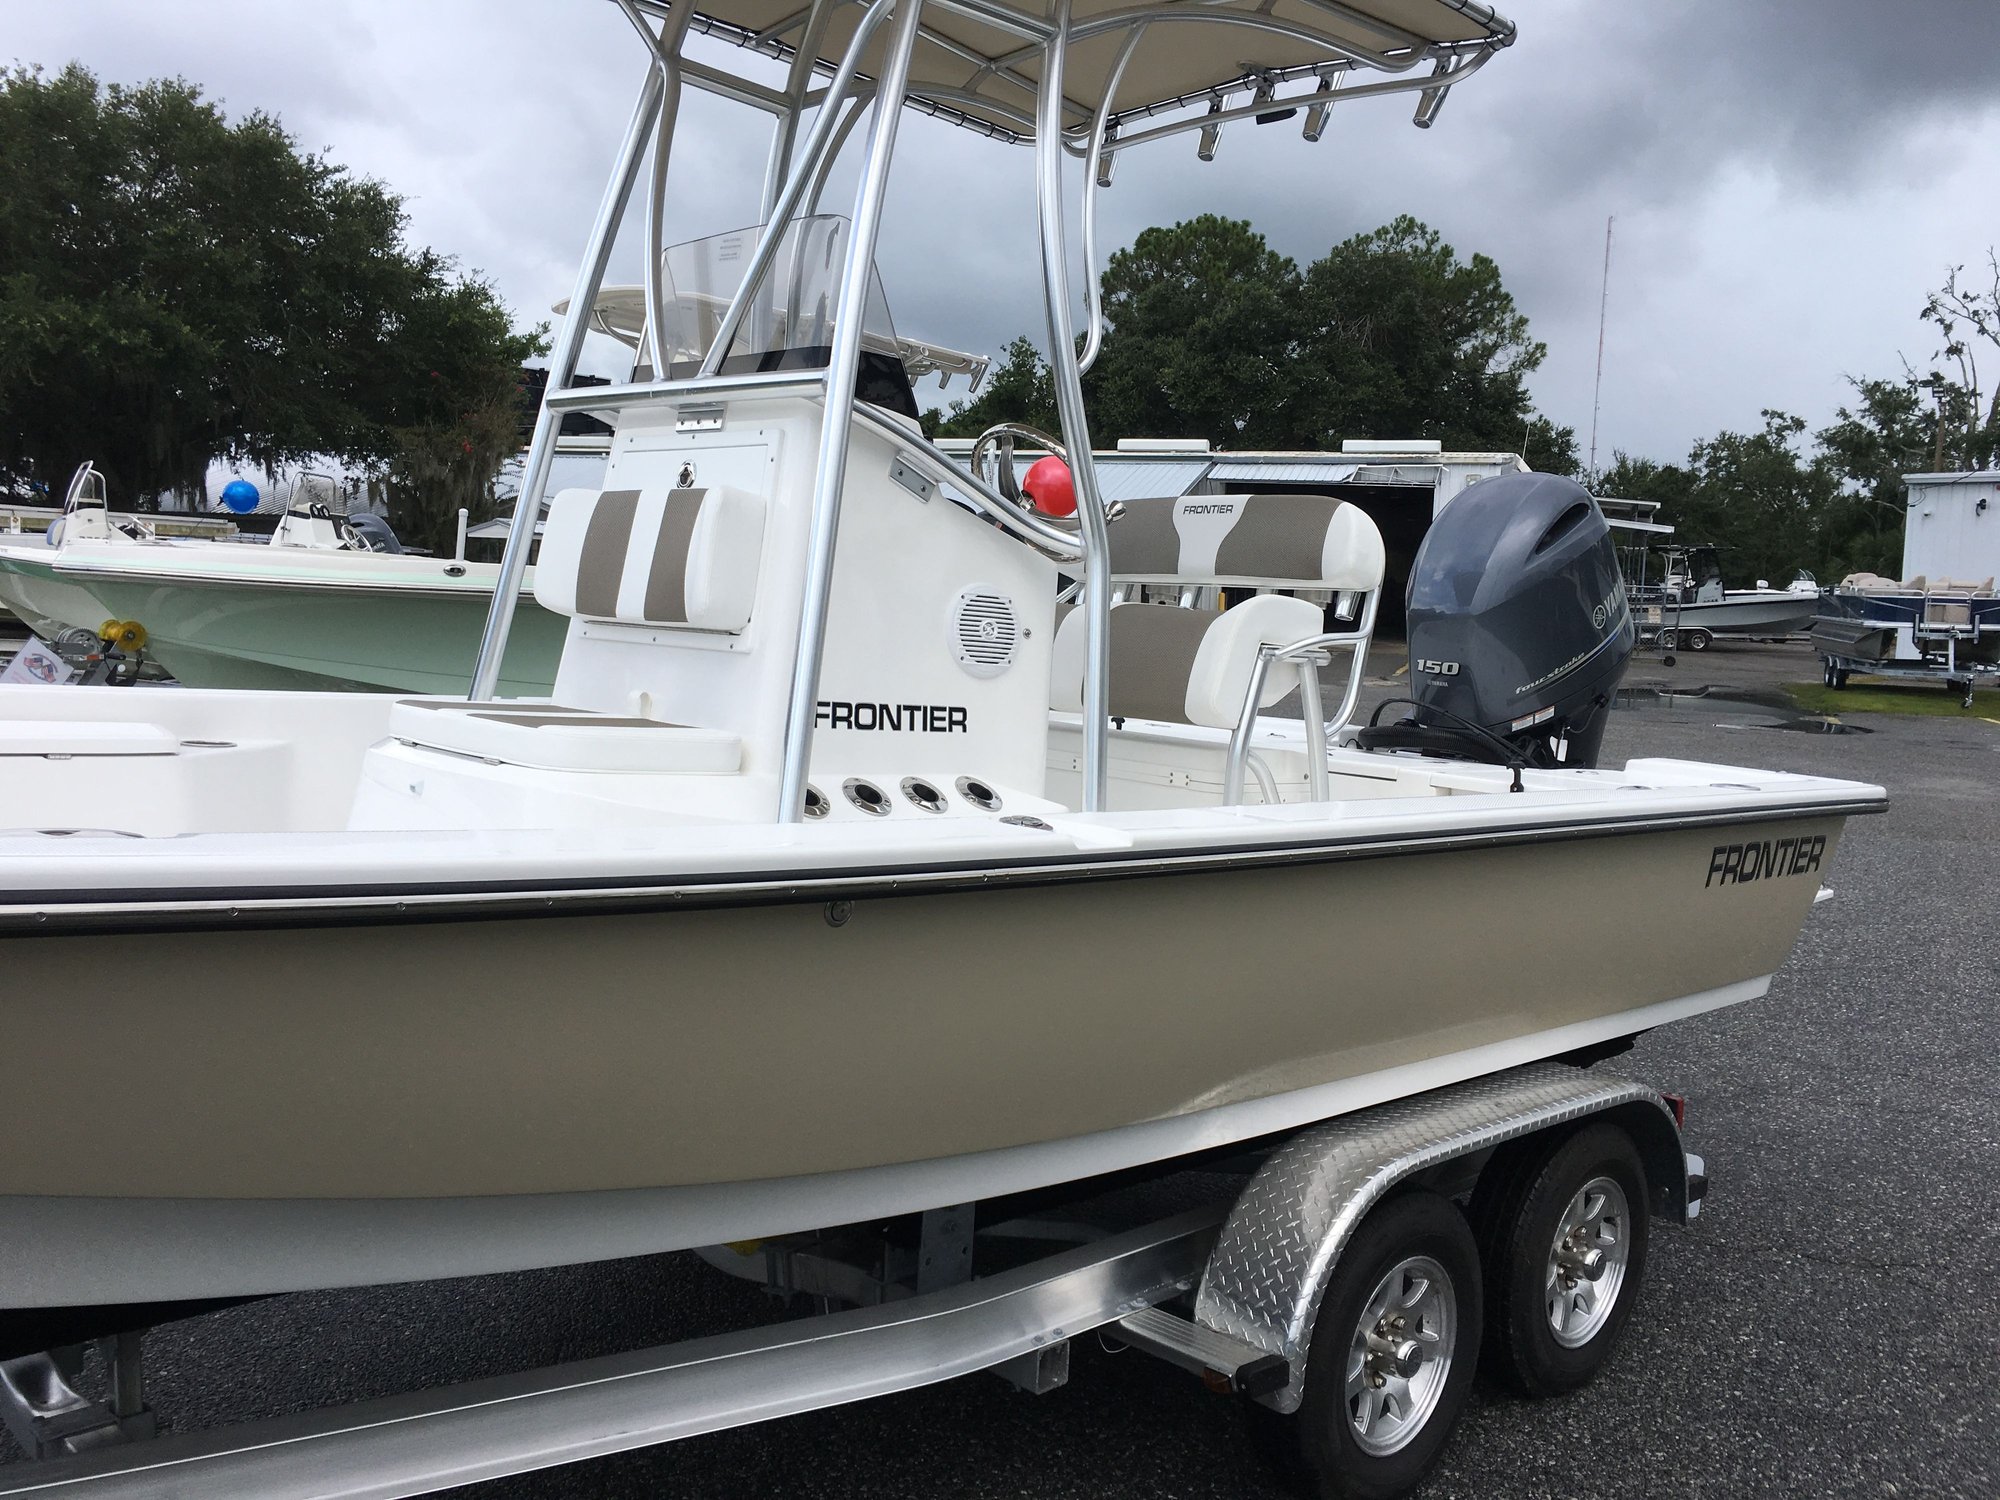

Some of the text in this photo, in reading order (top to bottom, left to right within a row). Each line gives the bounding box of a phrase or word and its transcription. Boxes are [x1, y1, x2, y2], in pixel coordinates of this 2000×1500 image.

[1183, 505, 1234, 515] FRONTIER
[1417, 659, 1460, 675] 150
[1515, 652, 1585, 694] fourstroke
[814, 701, 967, 733] FRONTIER
[1705, 835, 1826, 888] FRONTIER
